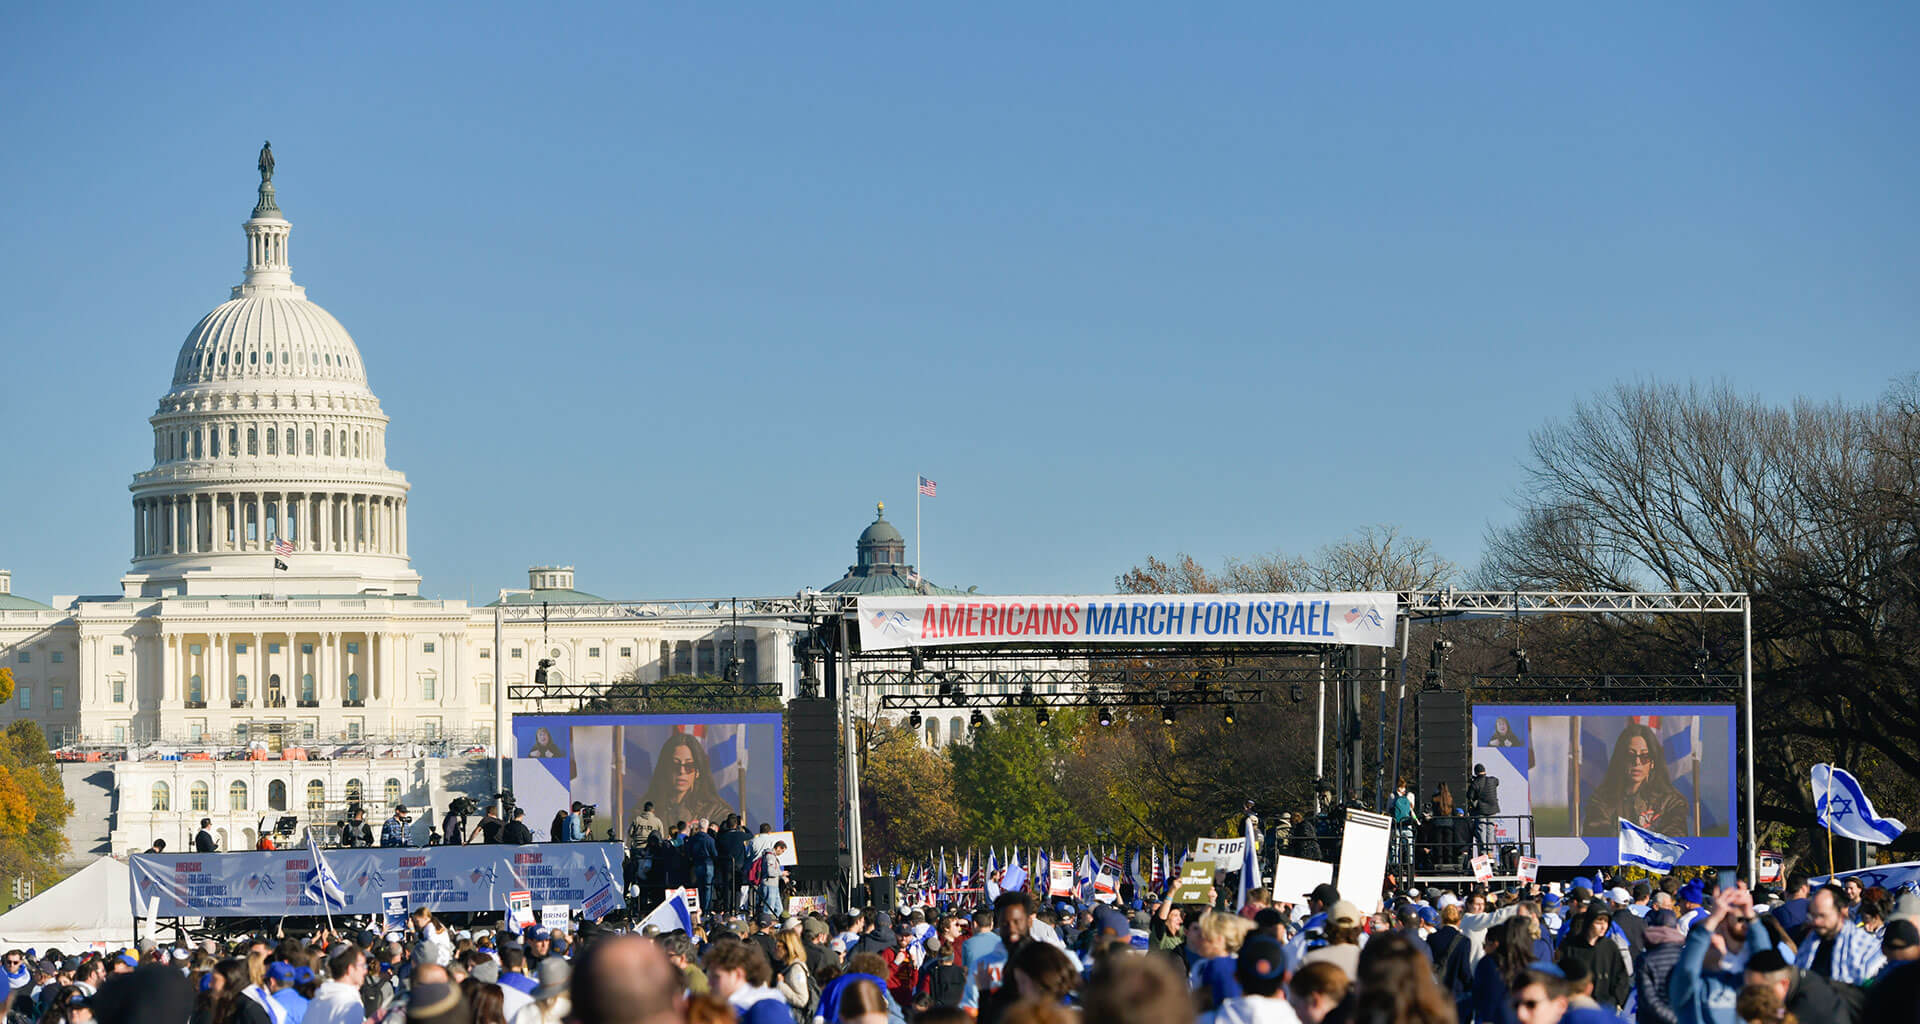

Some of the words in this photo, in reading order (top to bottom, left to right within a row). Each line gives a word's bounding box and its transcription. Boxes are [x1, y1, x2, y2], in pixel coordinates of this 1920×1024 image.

[921, 602, 1080, 639] AMERICANS
[1085, 602, 1185, 635] MARCH
[1190, 601, 1240, 635] FOR
[1245, 600, 1334, 636] ISRAEL
[1217, 841, 1245, 854] FIDF
[543, 911, 568, 919] BRING
